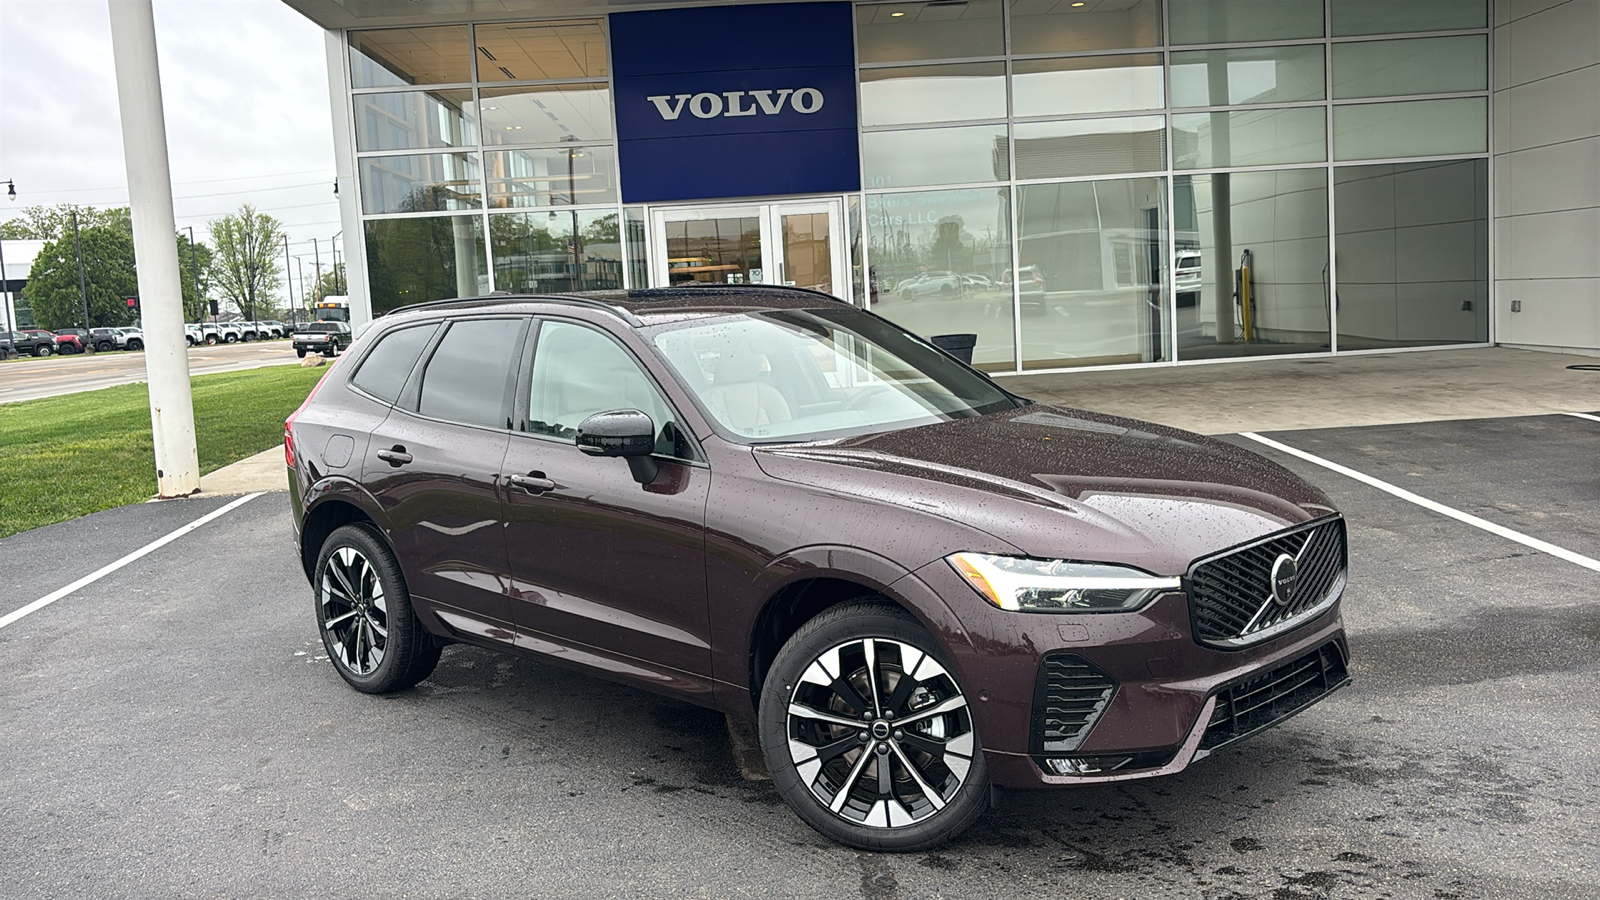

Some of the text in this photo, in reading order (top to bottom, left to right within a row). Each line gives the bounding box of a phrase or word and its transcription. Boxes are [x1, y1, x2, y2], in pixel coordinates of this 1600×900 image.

[647, 87, 824, 120] VOLVO
[868, 210, 937, 227] Cars LLC
